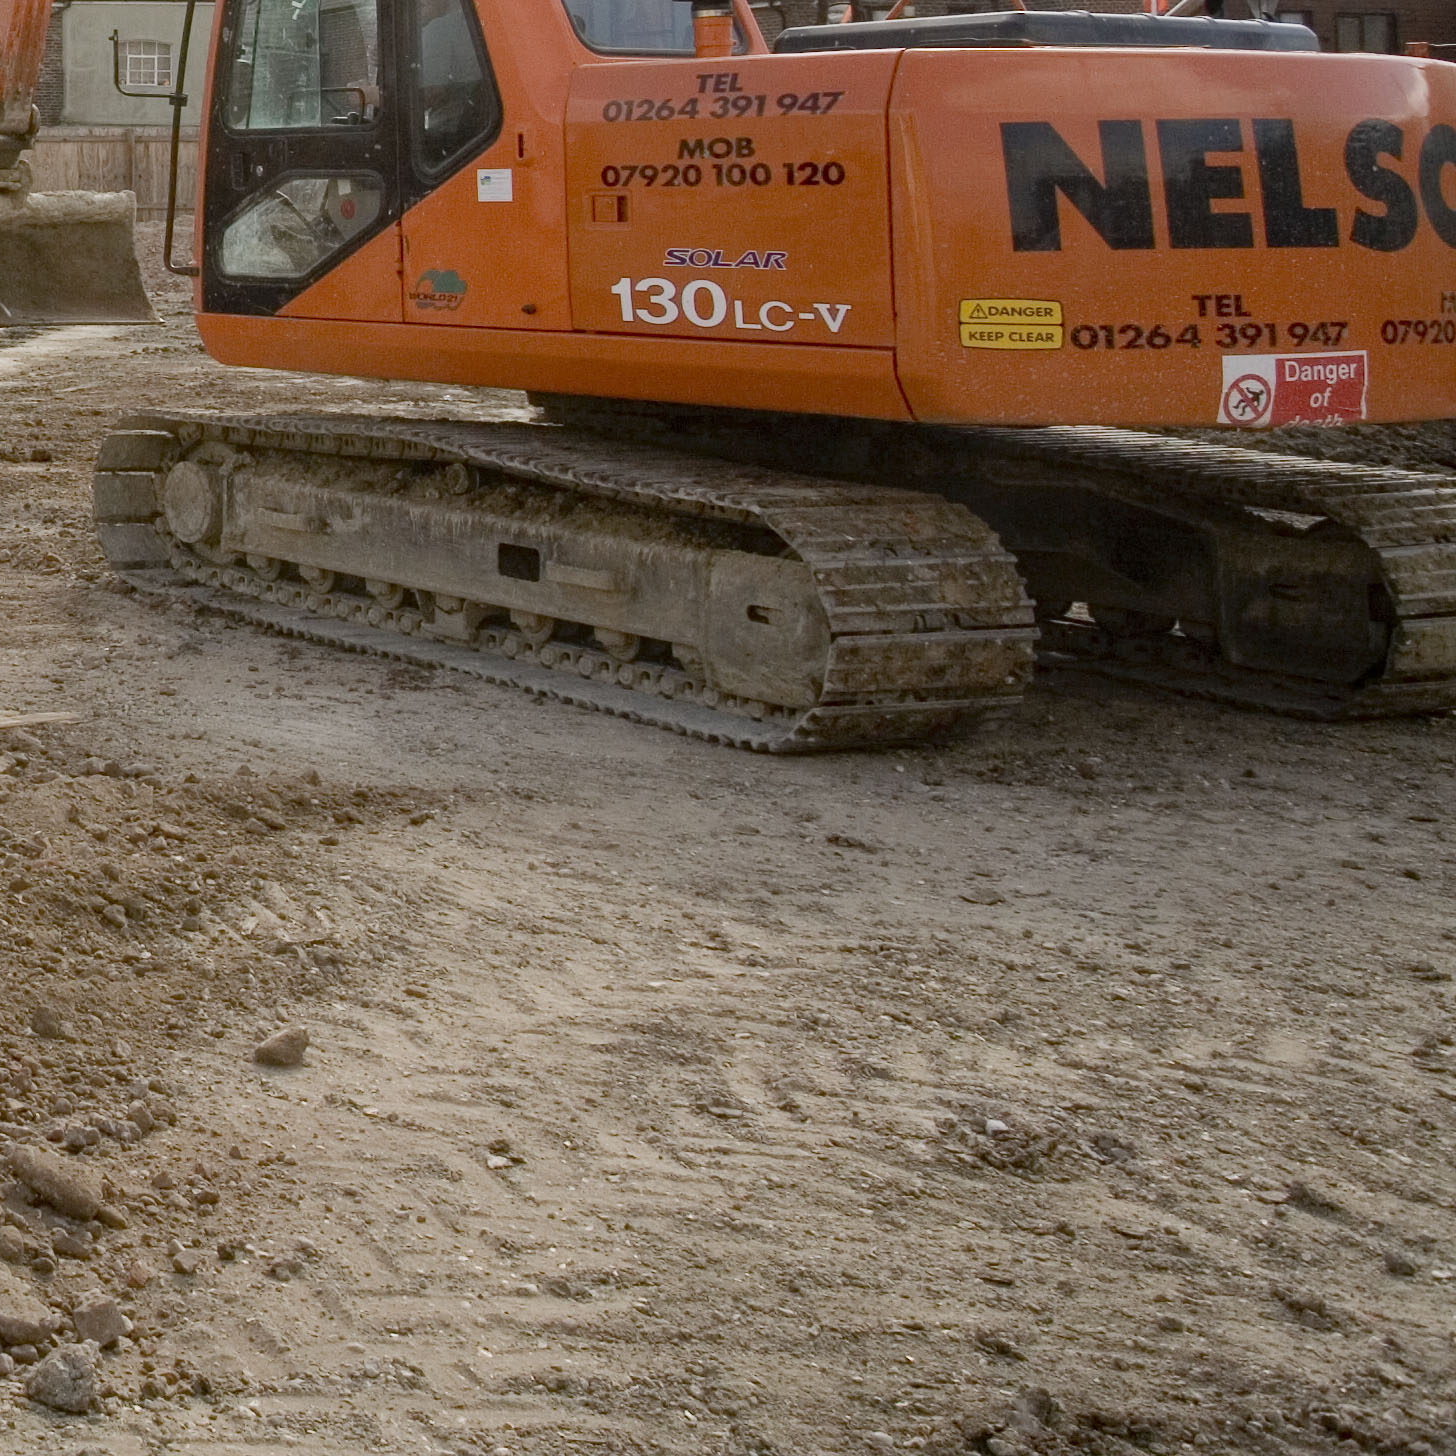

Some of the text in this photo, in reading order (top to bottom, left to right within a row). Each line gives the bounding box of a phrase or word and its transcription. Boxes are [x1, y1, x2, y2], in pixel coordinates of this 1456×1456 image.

[696, 73, 743, 93] TEL
[602, 91, 846, 122] 01264 391 947
[677, 137, 756, 159] MOB
[601, 162, 846, 187] 07920 100 120
[663, 247, 788, 270] SOLAR
[988, 306, 1054, 318] DANGER
[1192, 294, 1251, 317] TEL
[968, 330, 1055, 343] KEEP CLEAR
[1070, 321, 1348, 350] 01264 391 947
[1381, 320, 1456, 344] 07920
[1284, 360, 1358, 384] Danger
[1310, 388, 1332, 408] of
